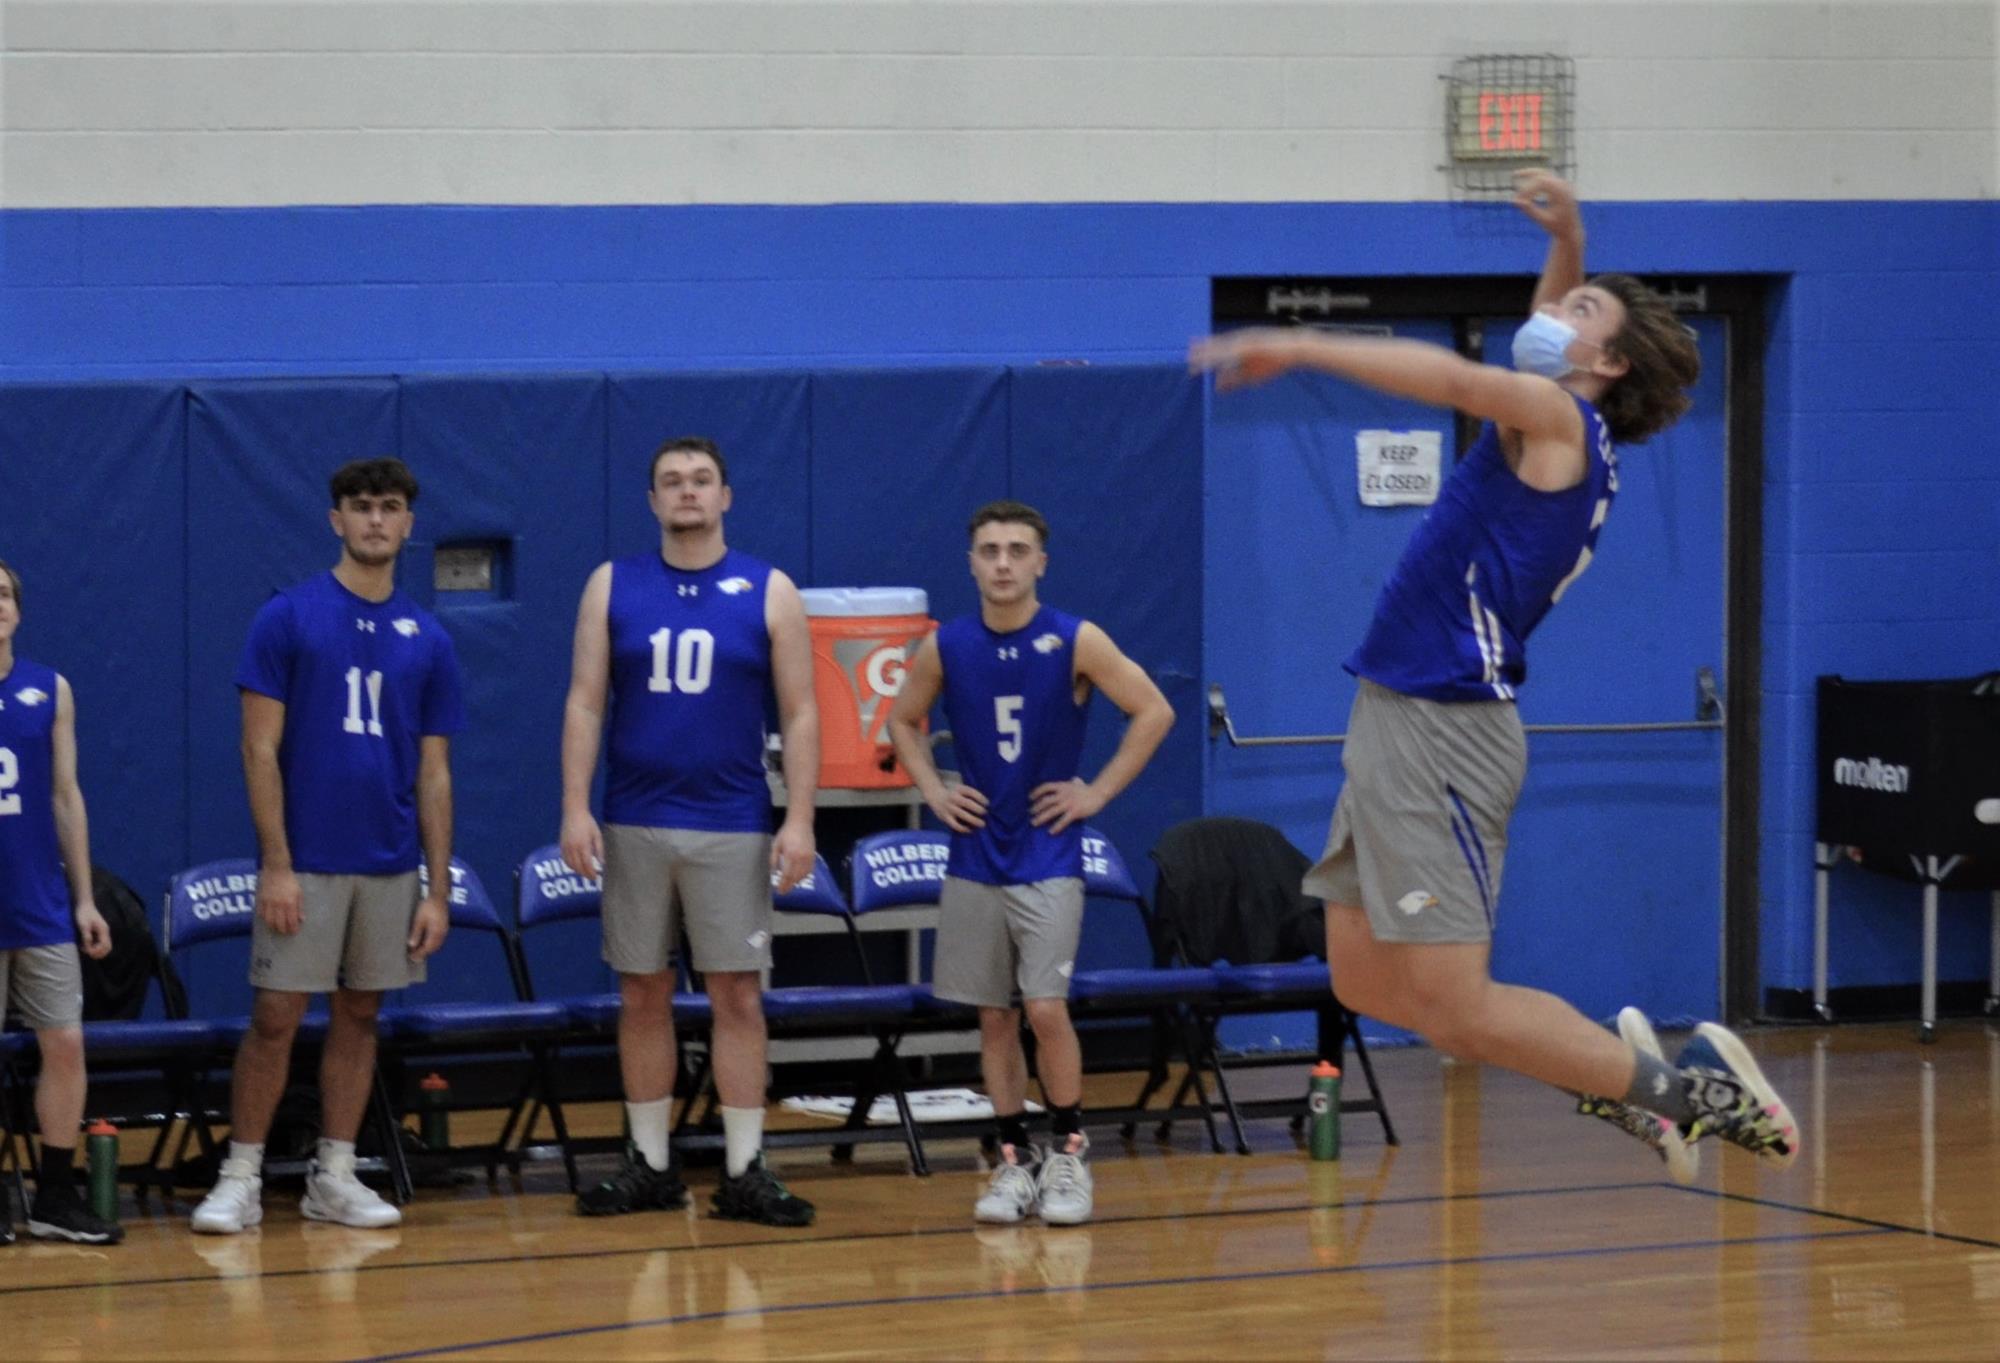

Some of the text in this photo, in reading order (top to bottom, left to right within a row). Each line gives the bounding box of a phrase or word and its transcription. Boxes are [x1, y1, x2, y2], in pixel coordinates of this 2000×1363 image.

[1479, 92, 1542, 150] EXIT
[1380, 444, 1419, 461] KEEP
[648, 627, 715, 694] 10
[866, 646, 907, 698] G
[342, 665, 383, 738] 11
[993, 695, 1024, 763] 5
[1833, 756, 1909, 793] molten
[864, 843, 950, 869] HILBER
[184, 874, 257, 901] HILBE
[540, 875, 603, 899] COLL
[192, 894, 256, 920] COLL
